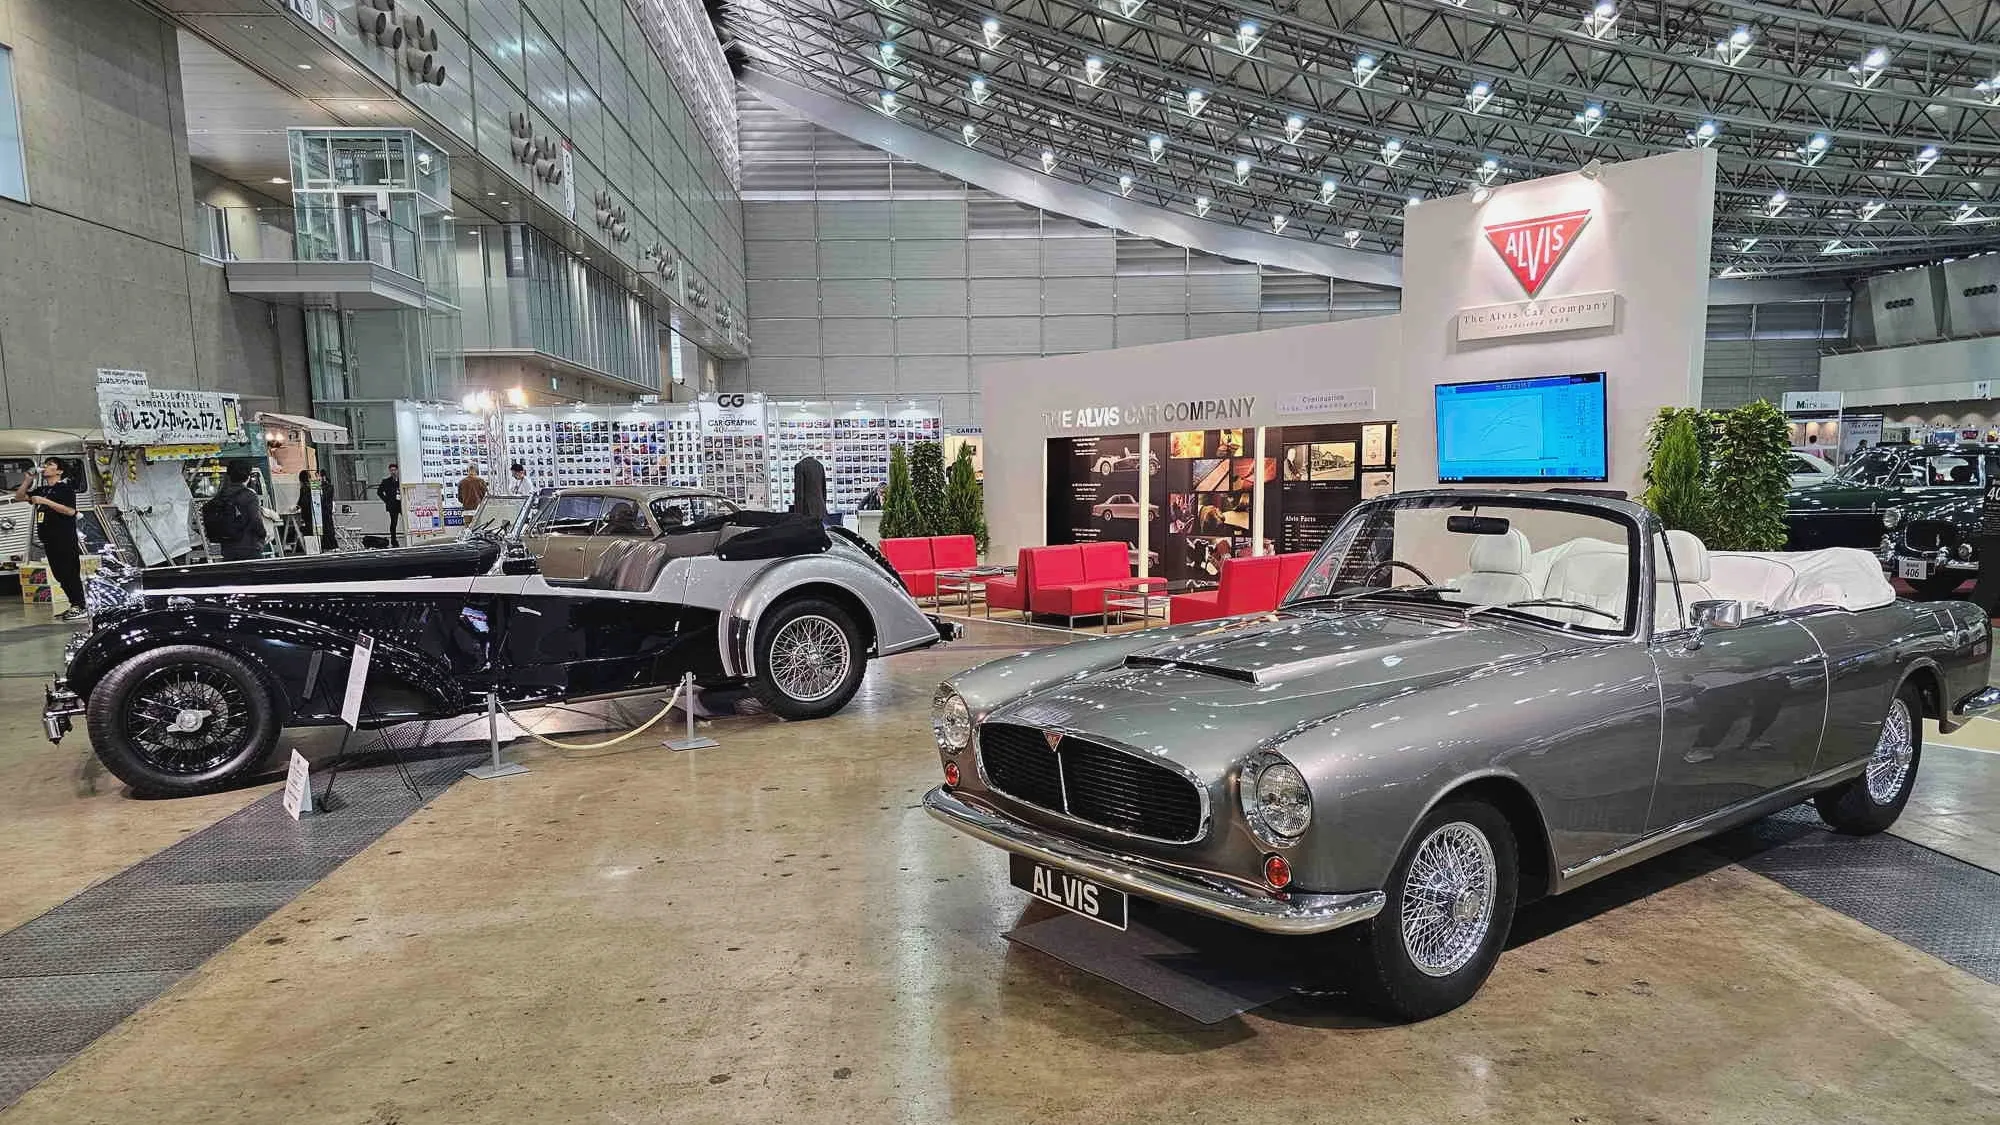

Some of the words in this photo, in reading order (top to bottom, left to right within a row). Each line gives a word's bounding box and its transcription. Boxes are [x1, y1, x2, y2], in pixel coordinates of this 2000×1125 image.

[1505, 224, 1564, 281] ALVIS
[1464, 315, 1484, 324] The
[1489, 312, 1519, 322] Alvis
[1524, 308, 1544, 318] Car
[1550, 301, 1608, 315] Company
[717, 394, 745, 408] CG
[1040, 409, 1074, 428] THE
[1076, 406, 1120, 427] ALVIS
[1124, 402, 1159, 424] CAR
[1163, 397, 1256, 422] COMPANY
[130, 408, 223, 431] レモンスカッシュカフェ
[1905, 568, 1920, 577] 406
[1033, 864, 1100, 915] ALVIS
